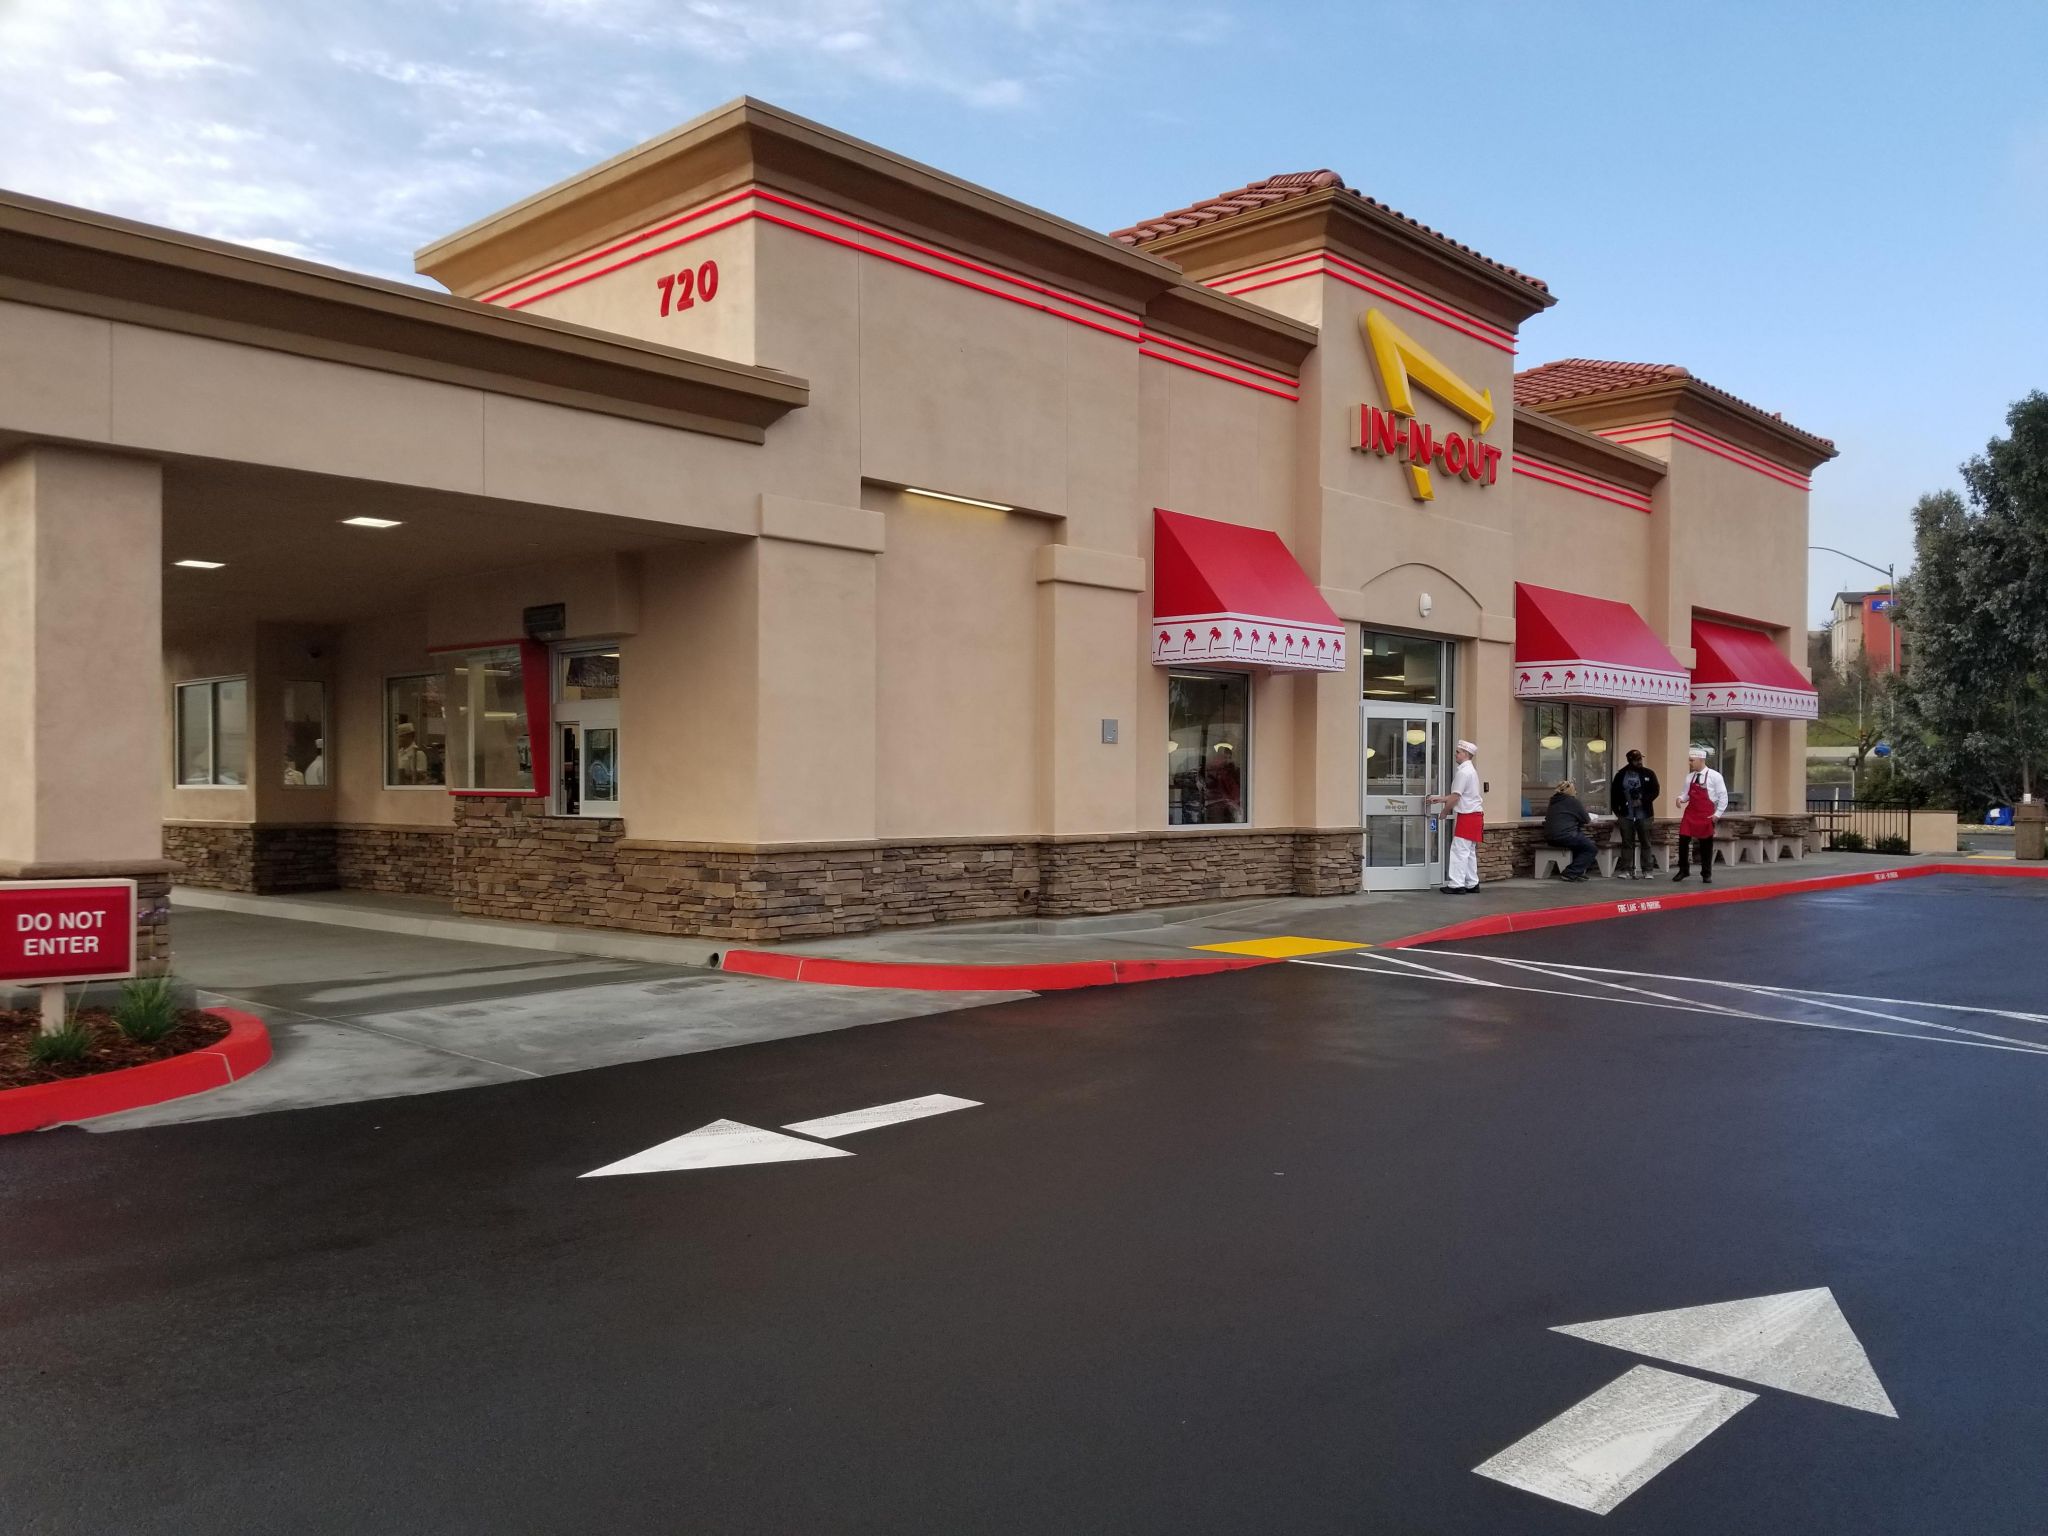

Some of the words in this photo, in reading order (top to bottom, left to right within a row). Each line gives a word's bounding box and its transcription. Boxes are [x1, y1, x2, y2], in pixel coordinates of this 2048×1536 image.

[657, 260, 719, 318] 720
[1358, 403, 1503, 486] IN-N-OUT
[17, 912, 52, 932] DO
[58, 910, 106, 930] NOT
[24, 936, 99, 956] ENTER
